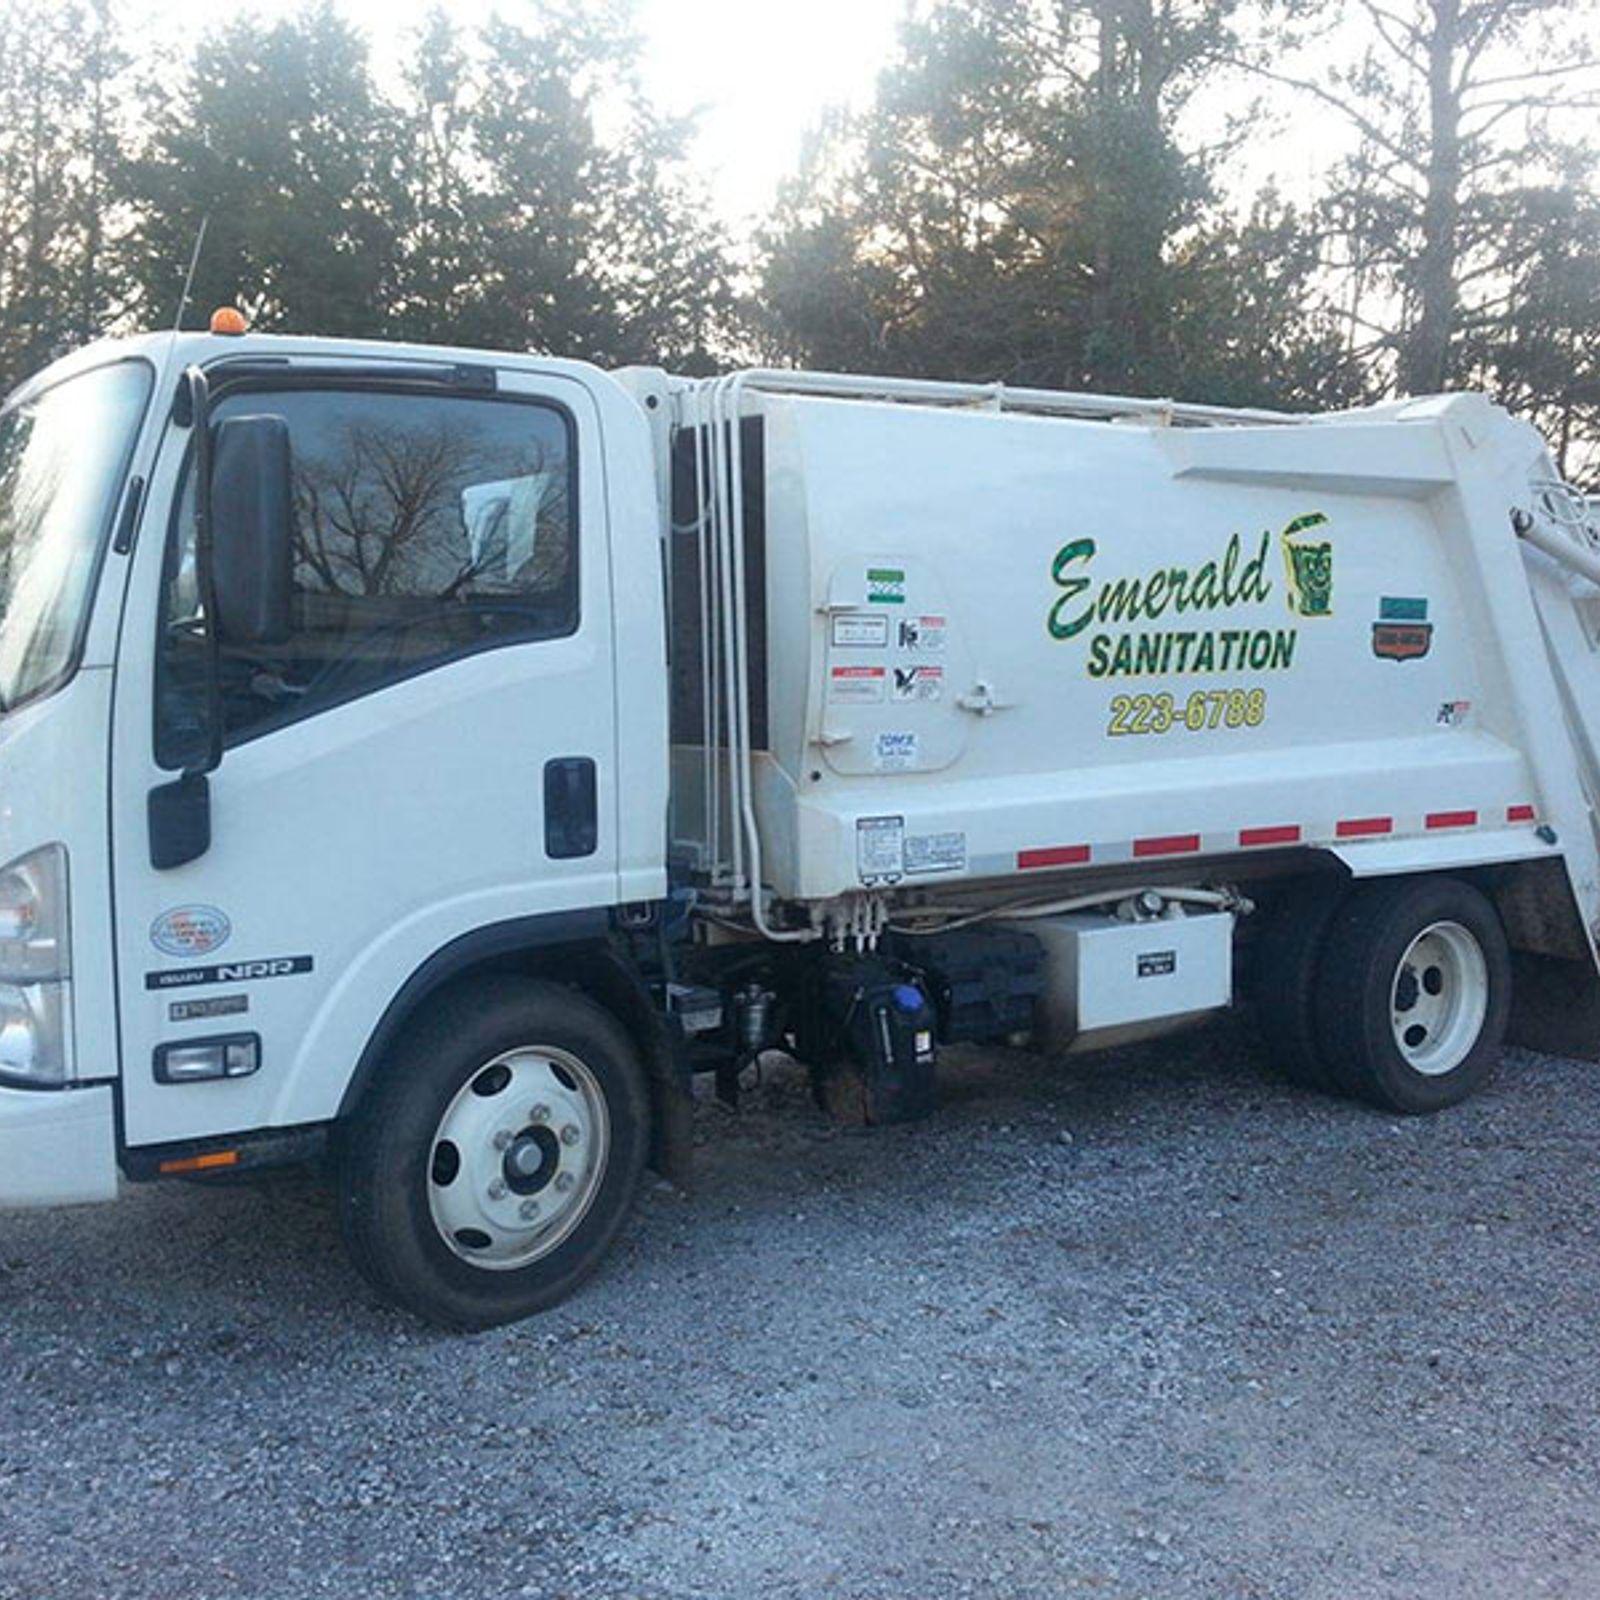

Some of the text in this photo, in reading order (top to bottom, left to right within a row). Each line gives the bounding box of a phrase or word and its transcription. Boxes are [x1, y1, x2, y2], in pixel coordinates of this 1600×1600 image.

[1048, 530, 1272, 640] Emerald
[1087, 629, 1297, 678] SANITATION
[1107, 688, 1266, 736] 223-6788
[217, 960, 294, 980] NRR
